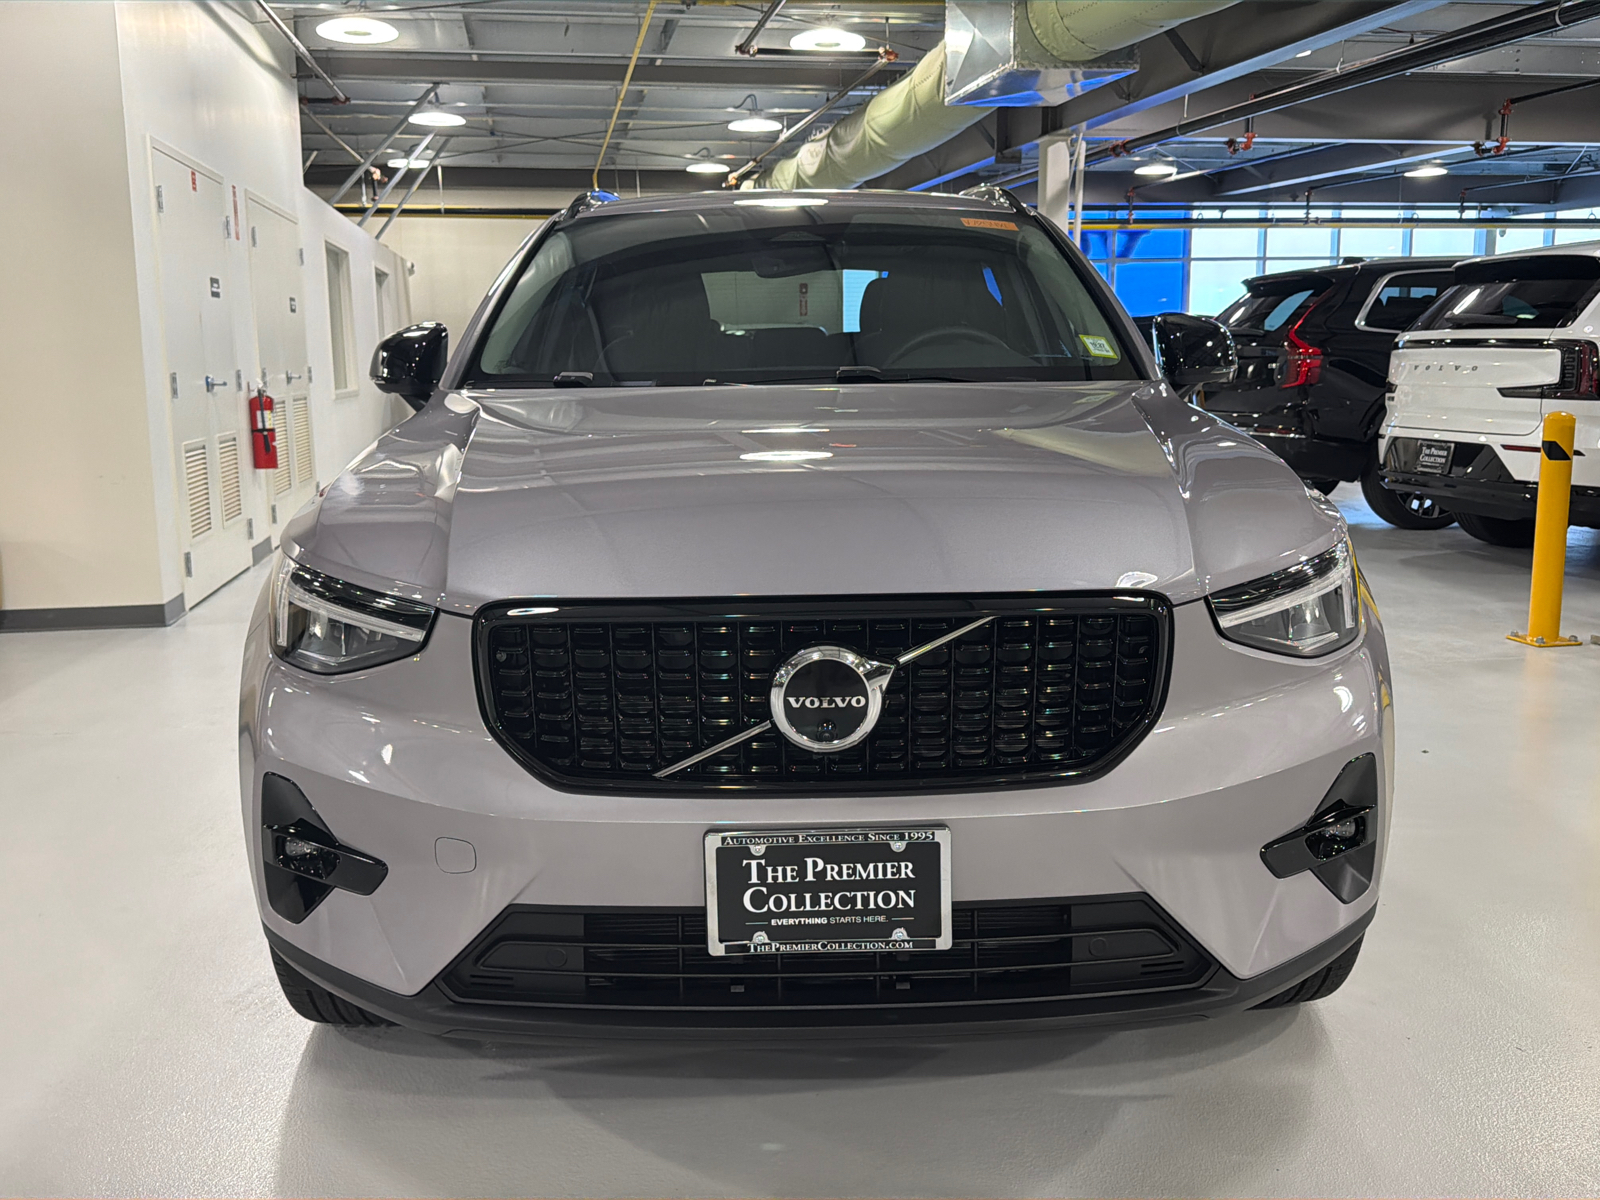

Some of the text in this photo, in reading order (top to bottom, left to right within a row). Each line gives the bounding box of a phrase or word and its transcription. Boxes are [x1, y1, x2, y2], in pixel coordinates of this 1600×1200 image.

[786, 696, 866, 708] VOLVO
[724, 832, 933, 845] AUTOMOTIVE EXCELLENCE SINCE 1995
[743, 857, 915, 884] THE PREMIER
[743, 886, 916, 912] COLLECTION
[771, 915, 889, 926] EVERYTHING STARTS HERE.
